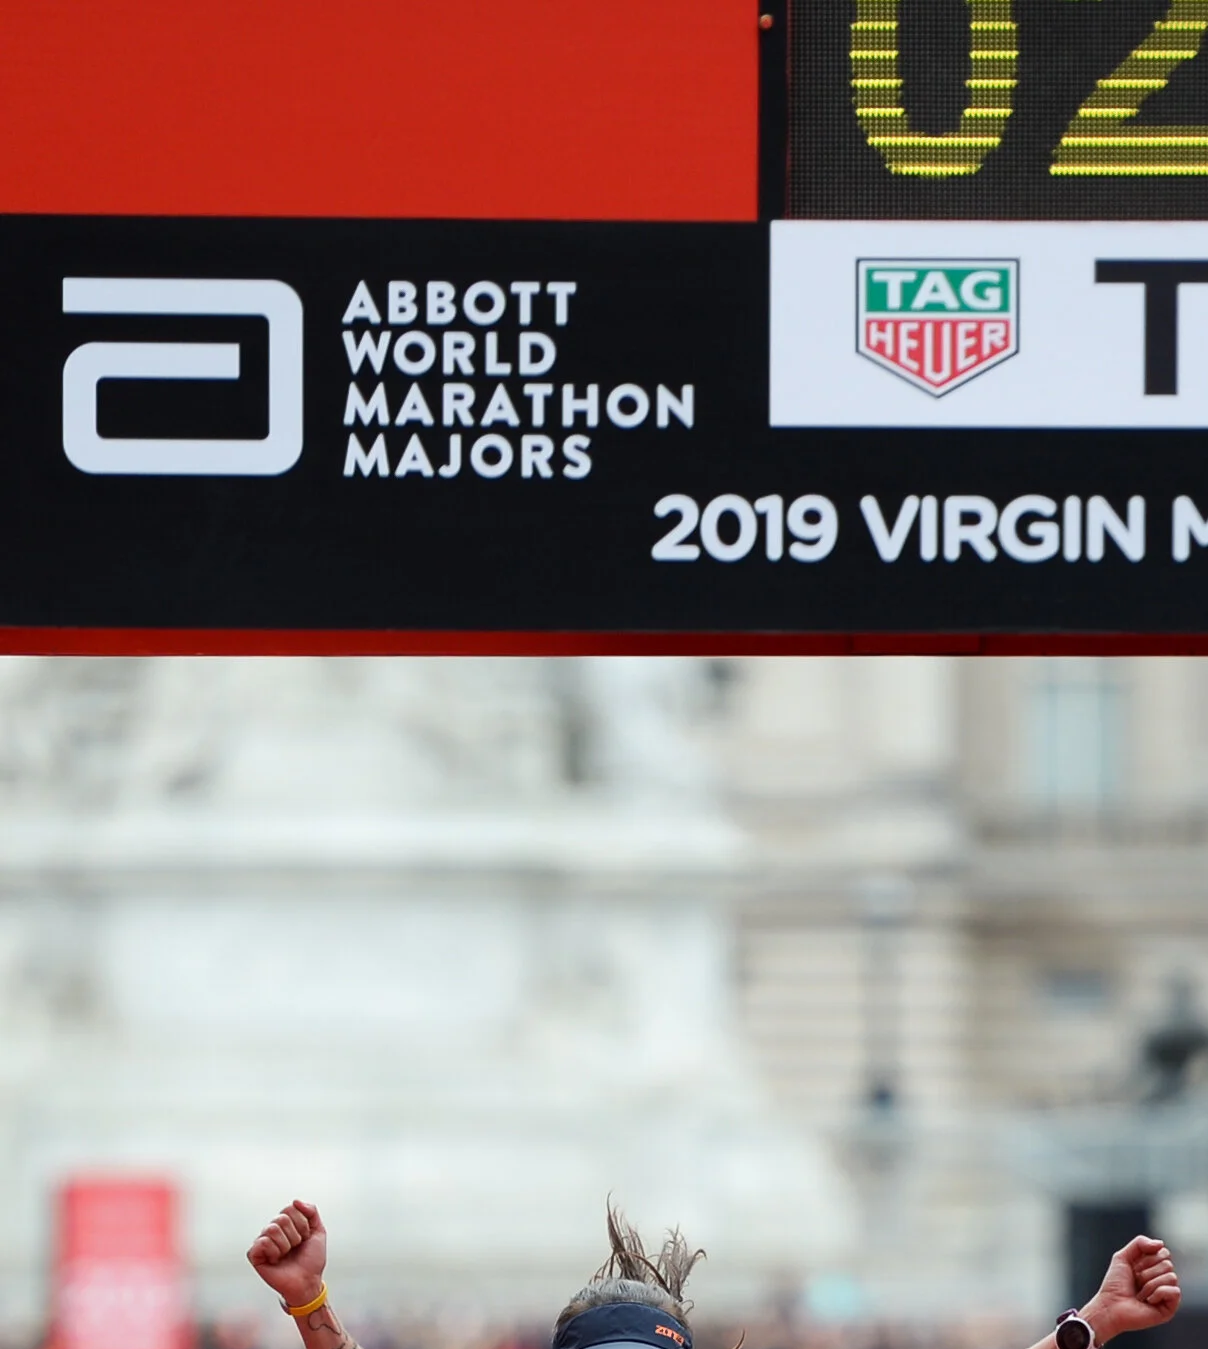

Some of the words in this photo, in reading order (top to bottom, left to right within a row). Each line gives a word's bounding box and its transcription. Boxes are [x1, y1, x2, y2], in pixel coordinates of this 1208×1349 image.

[342, 280, 577, 326] ABBOTT
[872, 270, 1003, 310] TAG
[342, 331, 557, 376] WORLD
[869, 321, 1007, 382] HEUER
[343, 382, 694, 428] MARATHON
[343, 433, 592, 479] MAJORS
[652, 495, 838, 562] 2019
[860, 494, 1146, 563] VIRGIN
